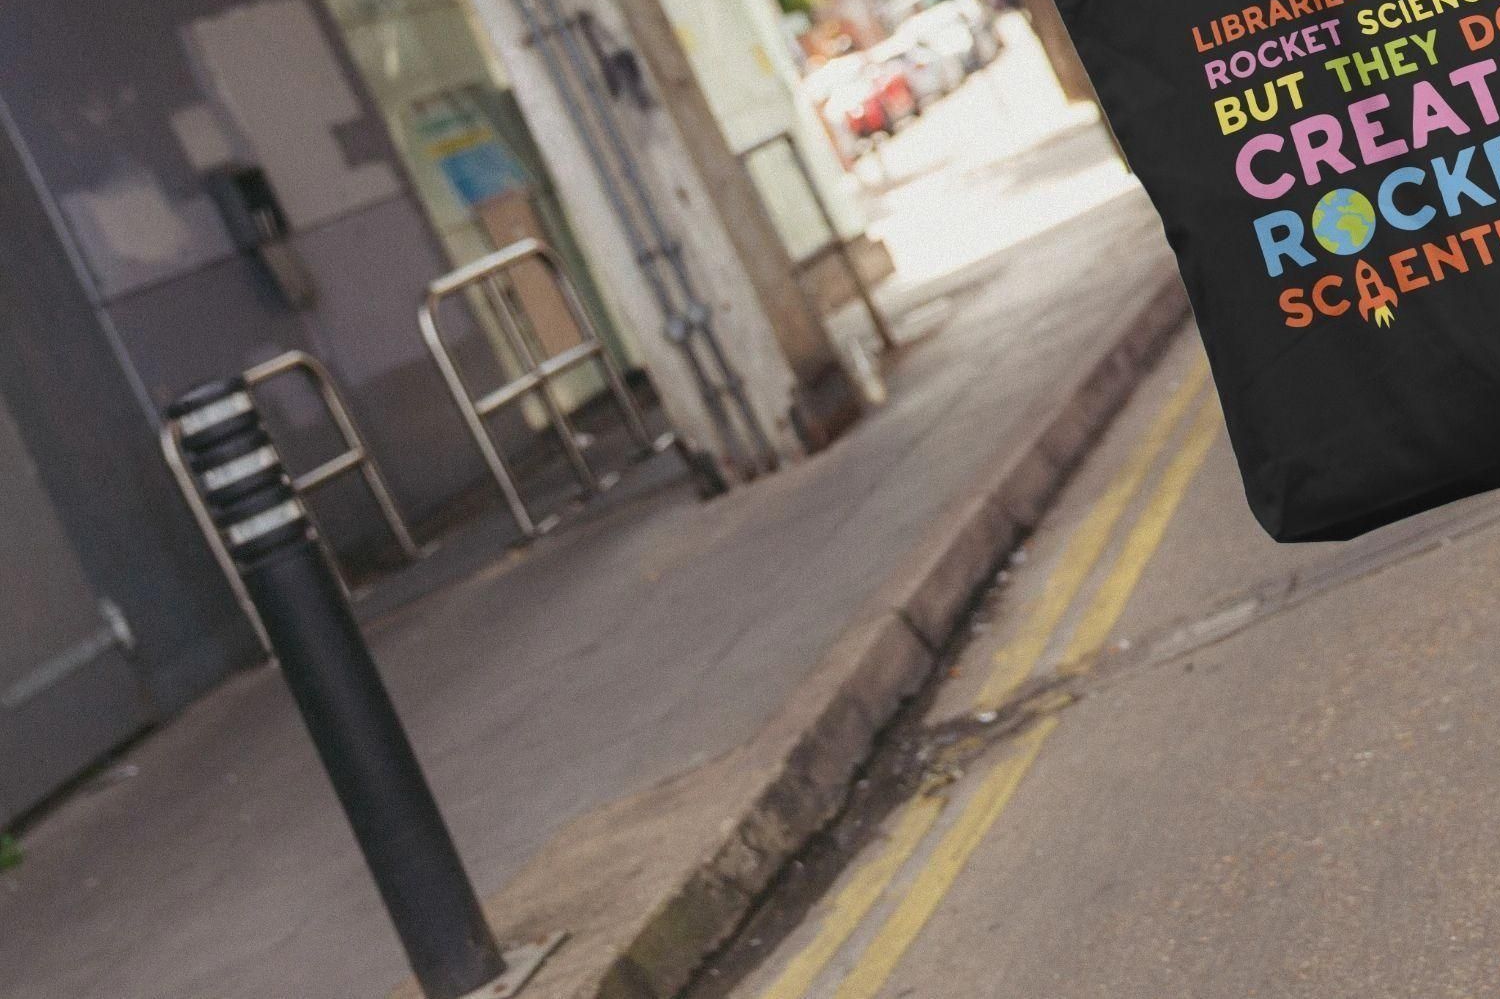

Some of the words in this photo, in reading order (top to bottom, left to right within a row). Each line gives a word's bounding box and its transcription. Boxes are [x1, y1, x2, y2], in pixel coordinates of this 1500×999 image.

[1205, 19, 1341, 90] ROCKET
[1213, 71, 1305, 136] BUT
[1324, 29, 1439, 93] THEY
